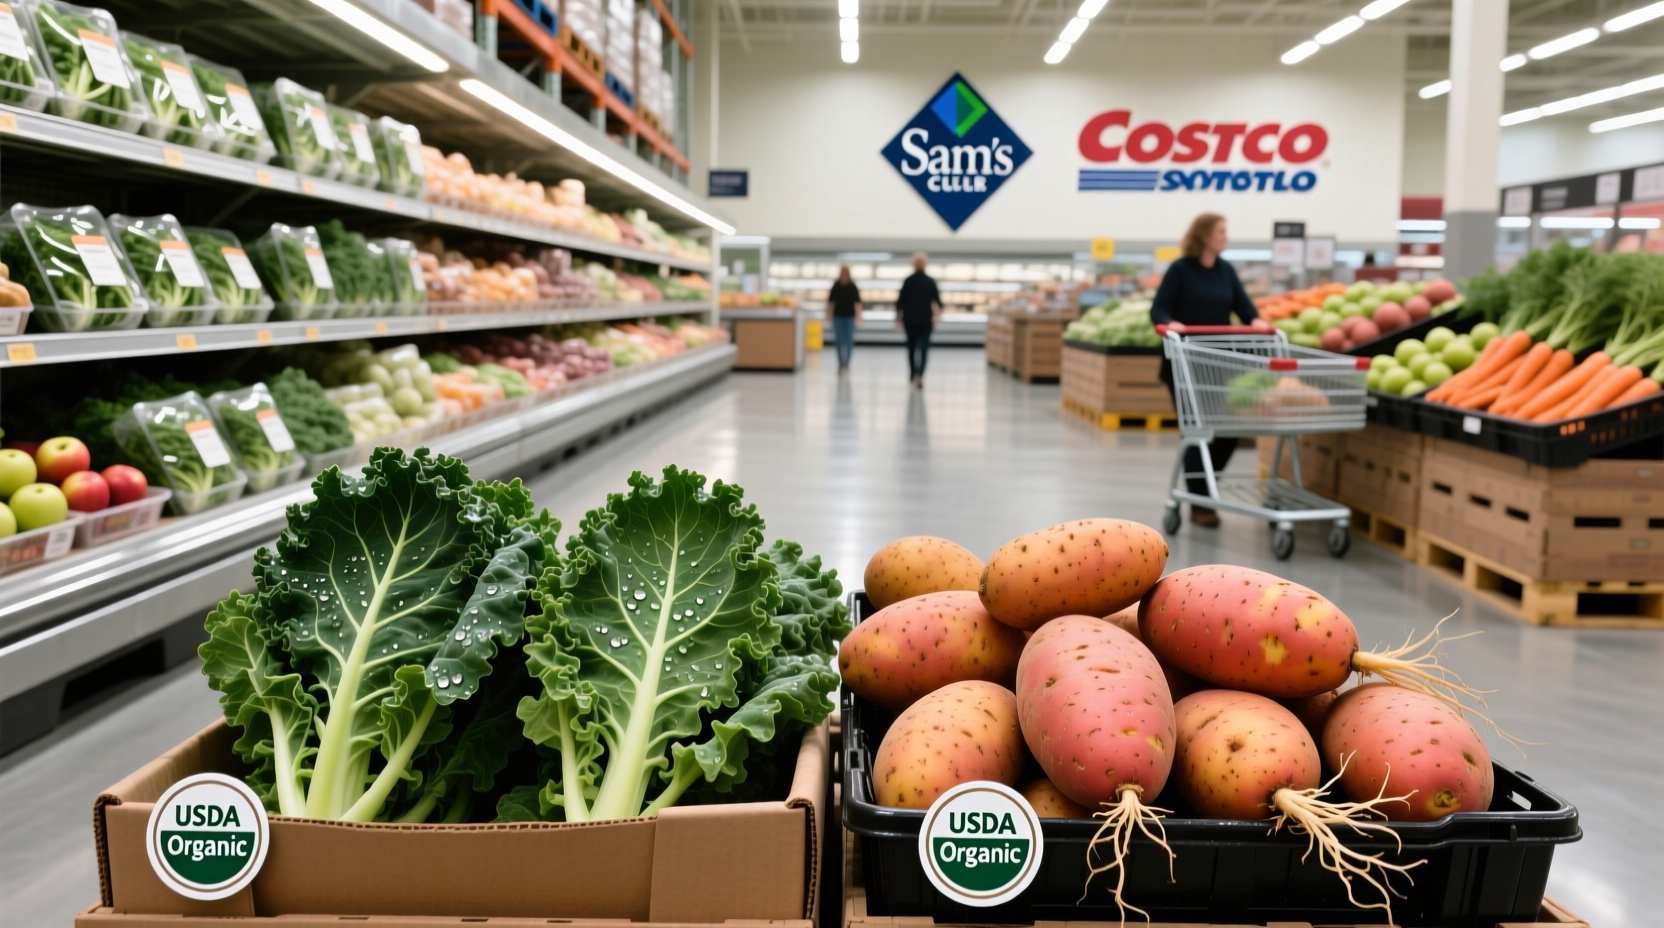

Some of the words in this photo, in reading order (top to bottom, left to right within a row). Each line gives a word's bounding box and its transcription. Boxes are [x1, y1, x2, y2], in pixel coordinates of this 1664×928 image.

[901, 127, 1014, 176] Sam's
[175, 804, 241, 827] USDA
[949, 811, 1017, 835] USDA
[167, 834, 248, 862] Organic
[939, 841, 1021, 868] Organic
